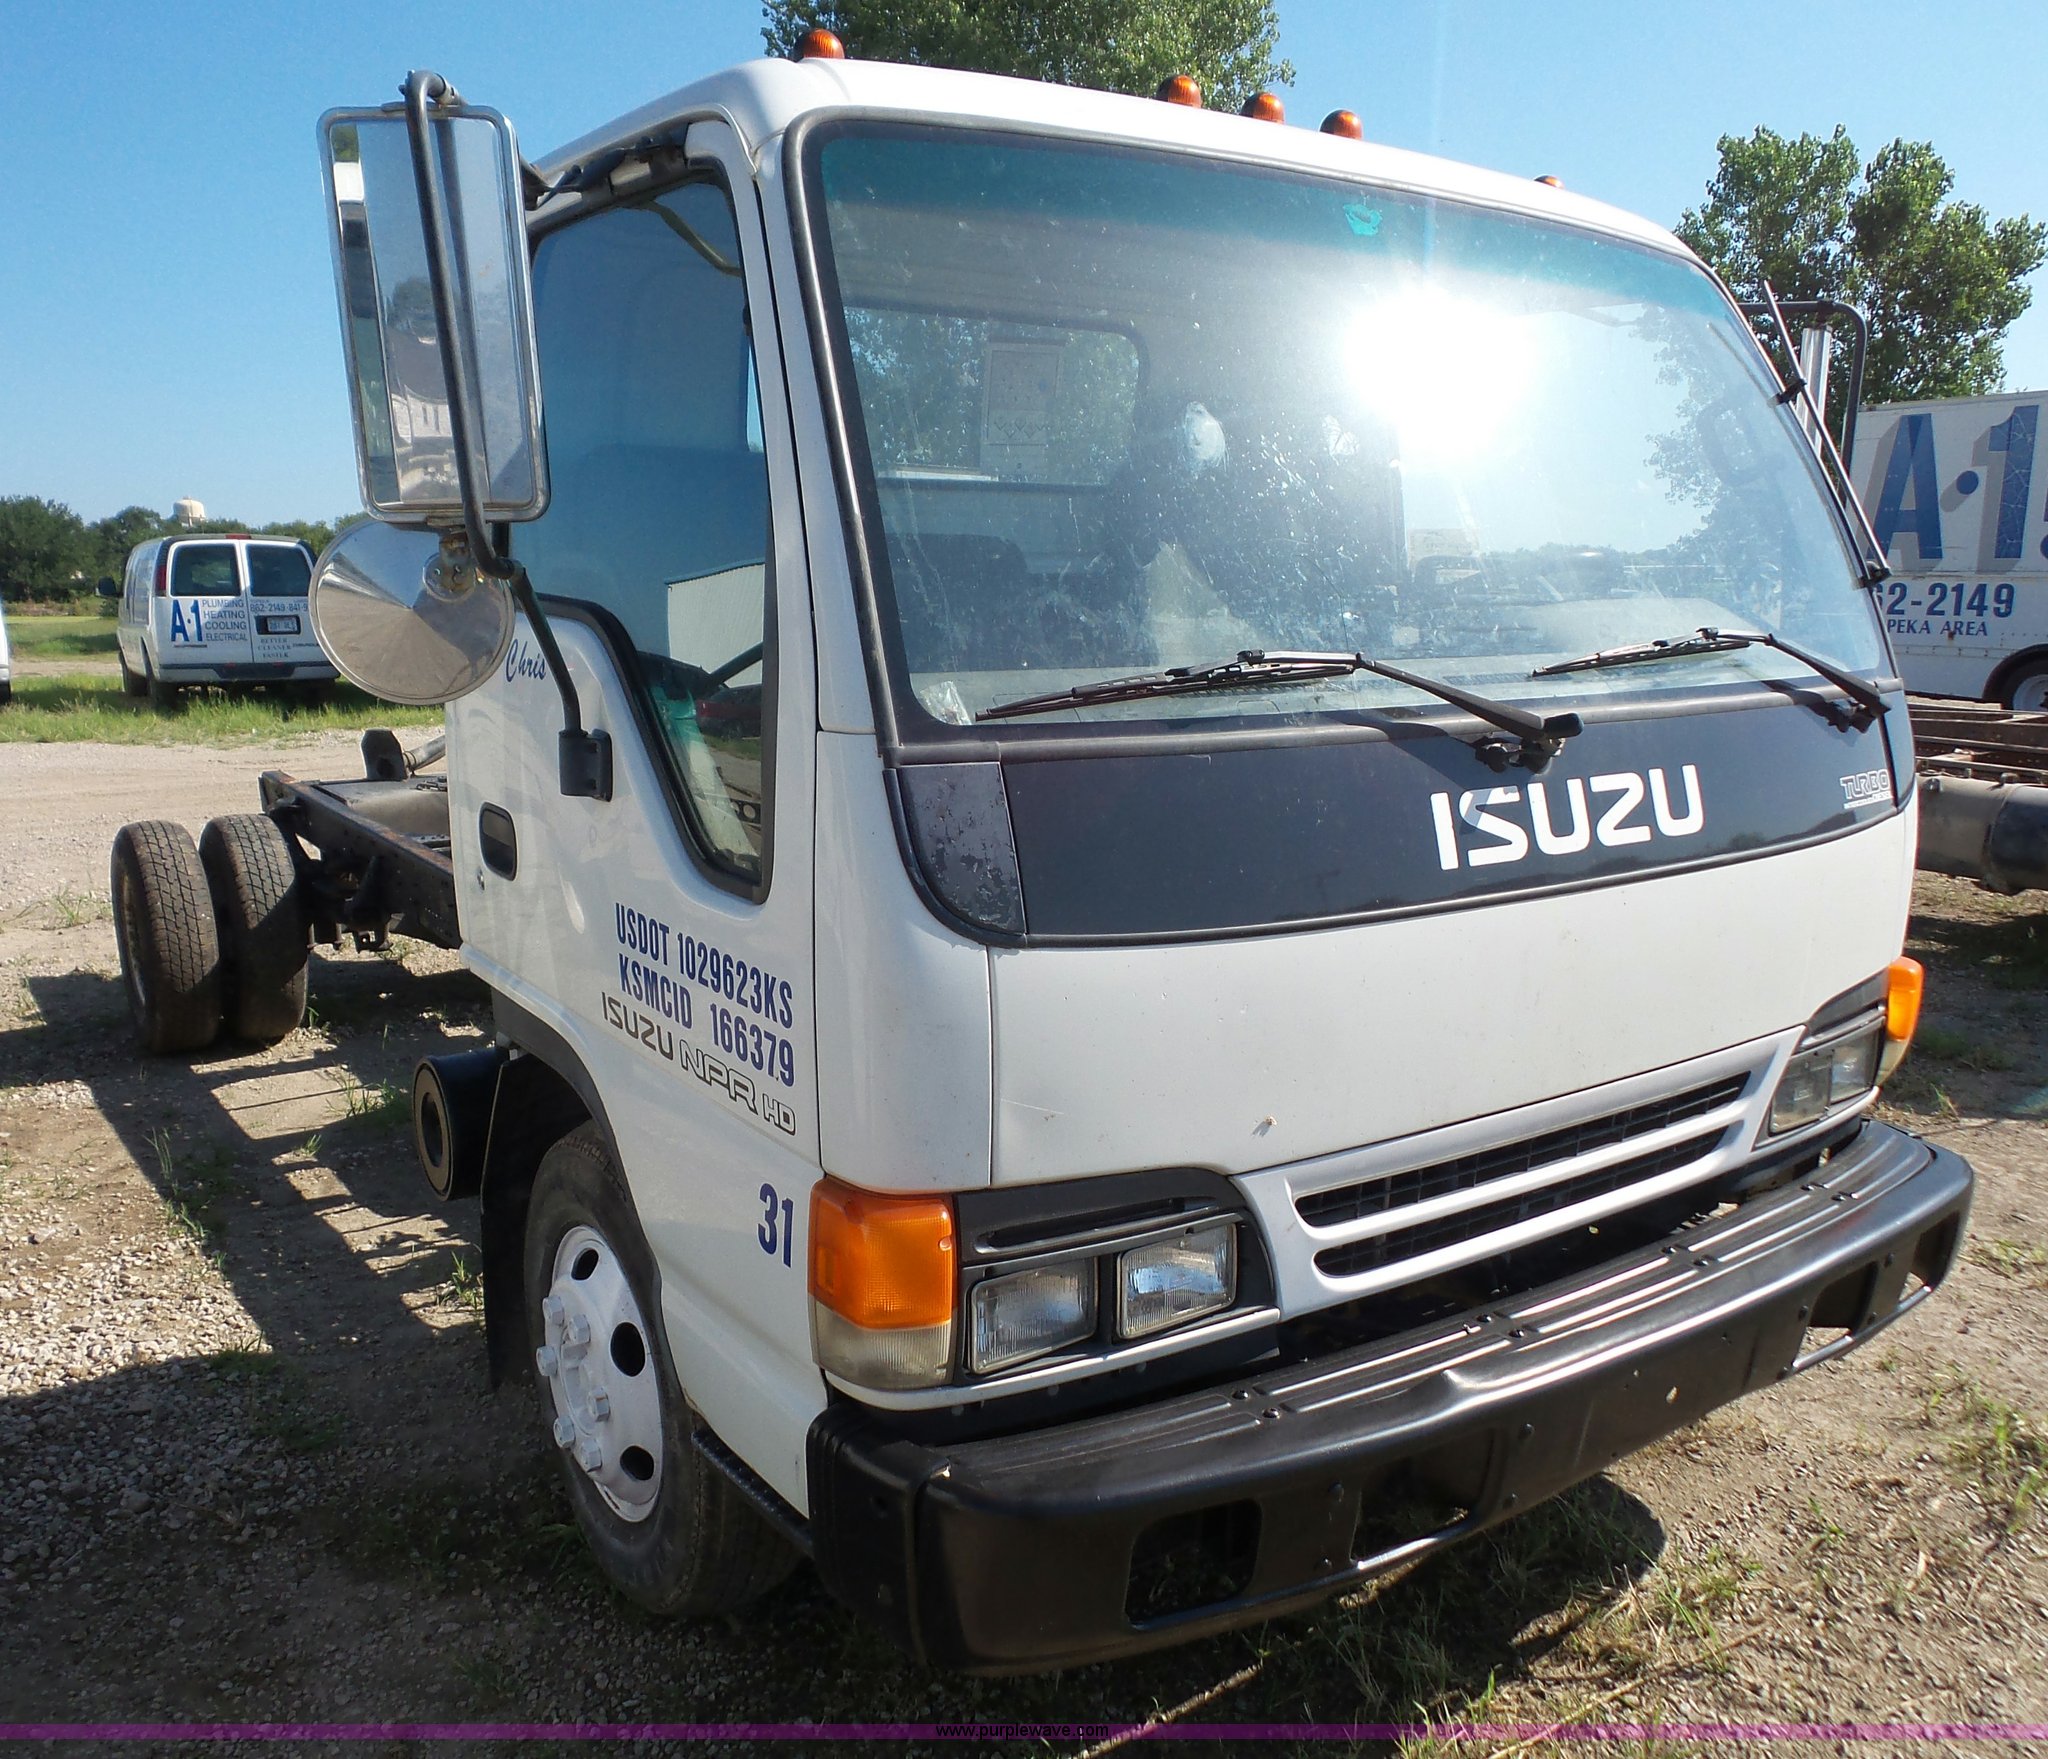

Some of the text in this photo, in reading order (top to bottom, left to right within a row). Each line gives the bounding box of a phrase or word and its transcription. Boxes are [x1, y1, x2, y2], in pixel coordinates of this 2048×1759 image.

[202, 598, 244, 608] PLUMBING
[203, 610, 246, 619] HEATING
[204, 621, 248, 630] COOLING
[205, 632, 248, 642] ELECTRICAL
[1940, 621, 1988, 637] AREA
[505, 638, 547, 683] Chris
[1839, 768, 1891, 800] TURBO
[1429, 763, 1705, 871] ISUZU
[615, 902, 793, 1030] USDOT 1029623KS
[618, 952, 796, 1088] KSMCID 166379
[601, 991, 796, 1137] ISUZU NPR HD
[757, 1182, 794, 1269] 31
